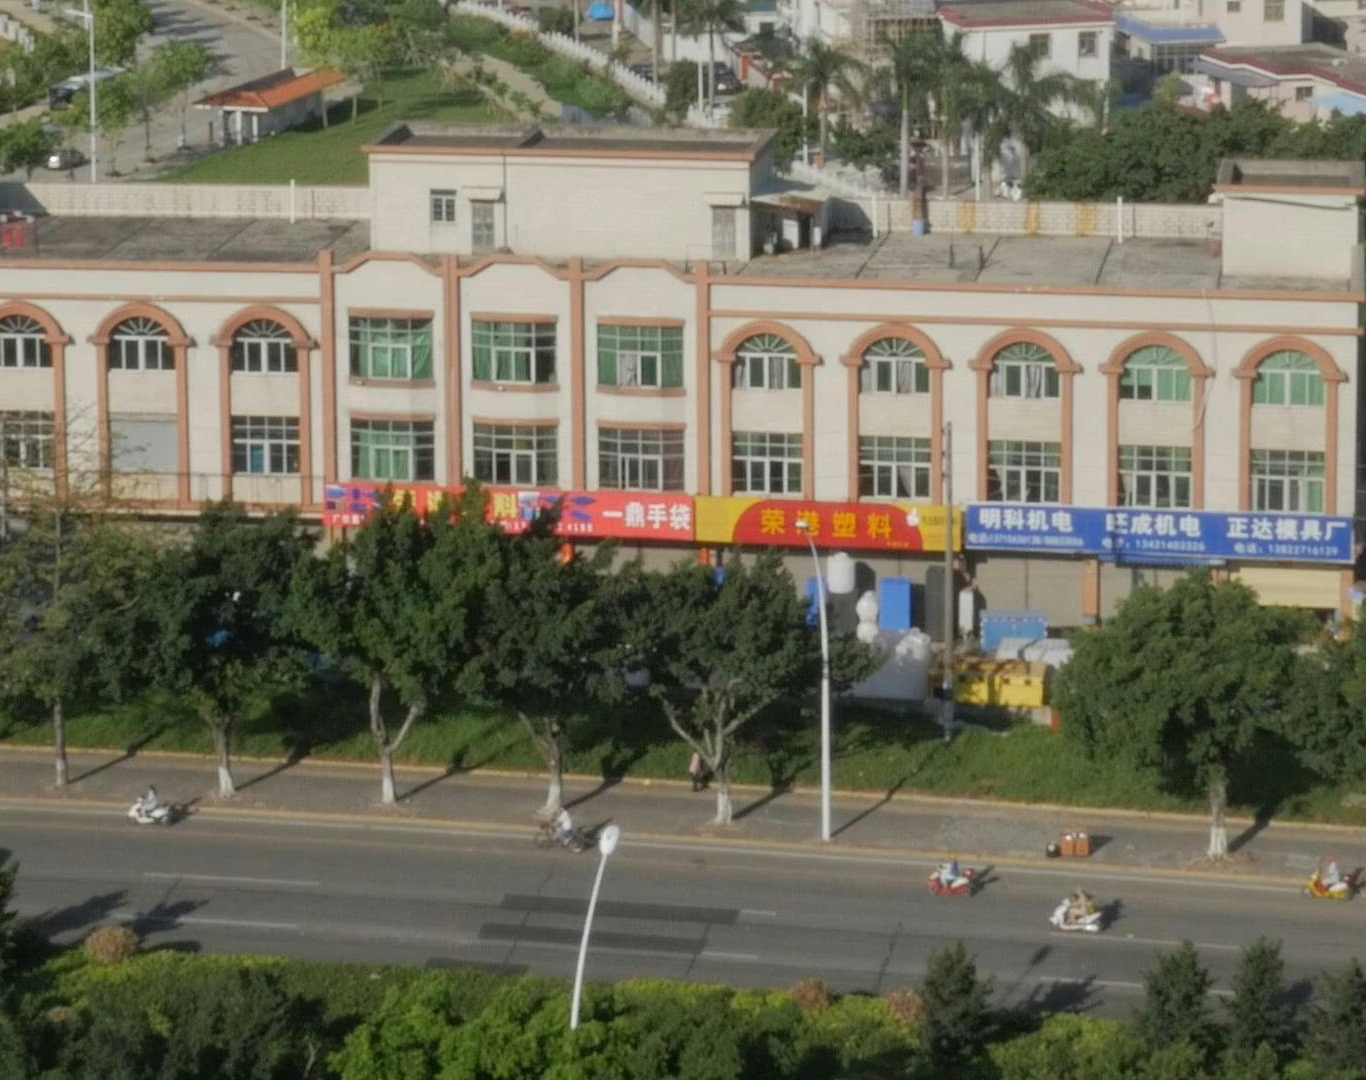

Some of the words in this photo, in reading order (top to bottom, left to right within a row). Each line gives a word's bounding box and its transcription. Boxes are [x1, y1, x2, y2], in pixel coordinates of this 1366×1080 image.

[602, 501, 692, 531] 一鼎手袋
[761, 508, 893, 539] 荣港塑料
[979, 508, 1073, 533] 明科机电
[1105, 513, 1201, 537] 旺成机电
[1226, 517, 1347, 541] 正达模具厂
